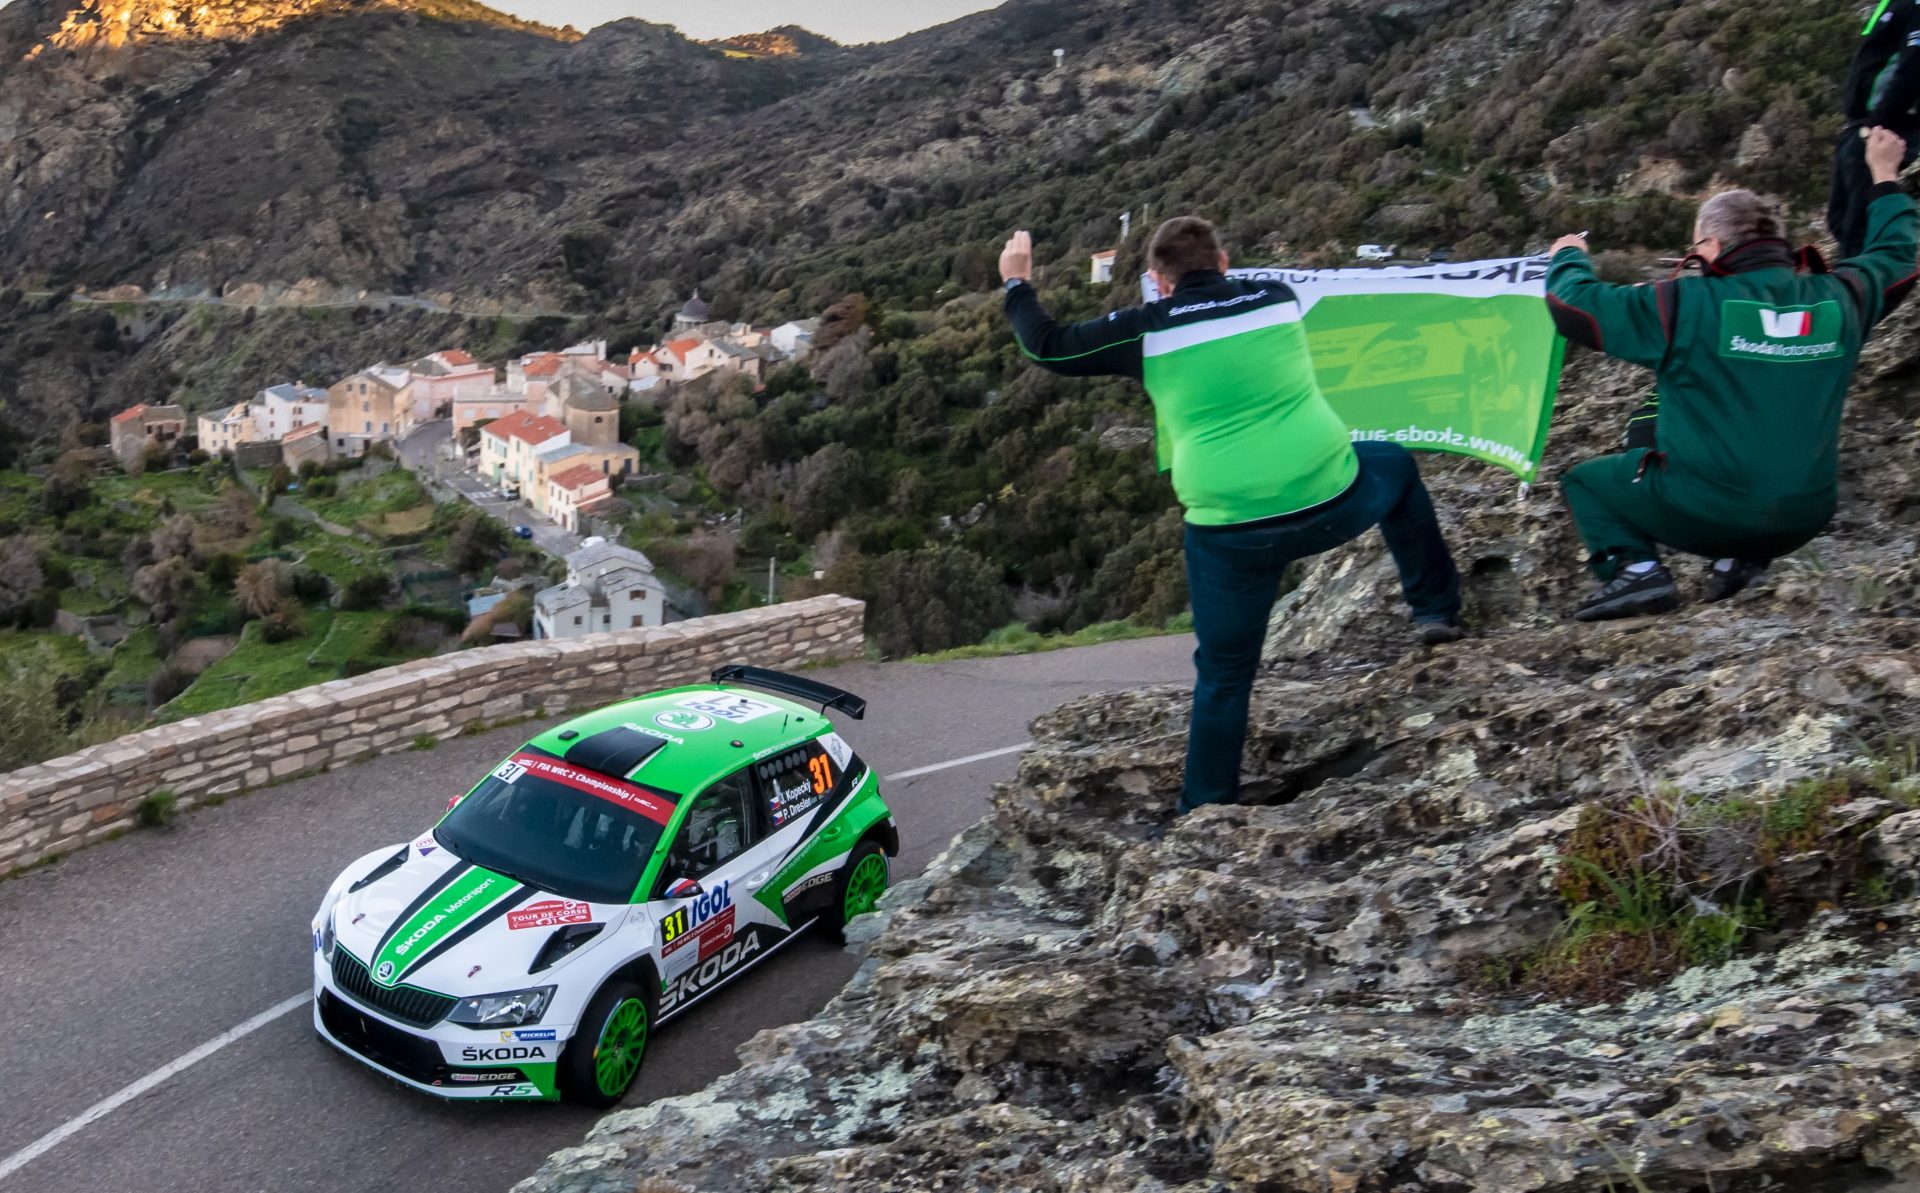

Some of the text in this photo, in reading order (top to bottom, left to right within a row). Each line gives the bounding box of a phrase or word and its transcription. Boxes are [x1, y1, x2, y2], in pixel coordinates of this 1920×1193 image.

[500, 763, 518, 780] 31
[537, 762, 551, 772] FIA
[550, 766, 568, 777] WRC
[568, 771, 576, 779] 2
[575, 773, 630, 800] Championship
[809, 753, 833, 794] 31
[783, 809, 790, 820] P.
[790, 798, 812, 815] Dresler
[800, 872, 833, 891] EDGE
[443, 878, 496, 914] Motorsport
[692, 880, 731, 928] IGOL
[512, 914, 539, 922] TOUR
[557, 908, 587, 916] CORSE
[665, 910, 683, 942] 31
[462, 1046, 546, 1061] ŠKODA
[479, 1072, 517, 1081] EDGE
[490, 1085, 535, 1096] R5
